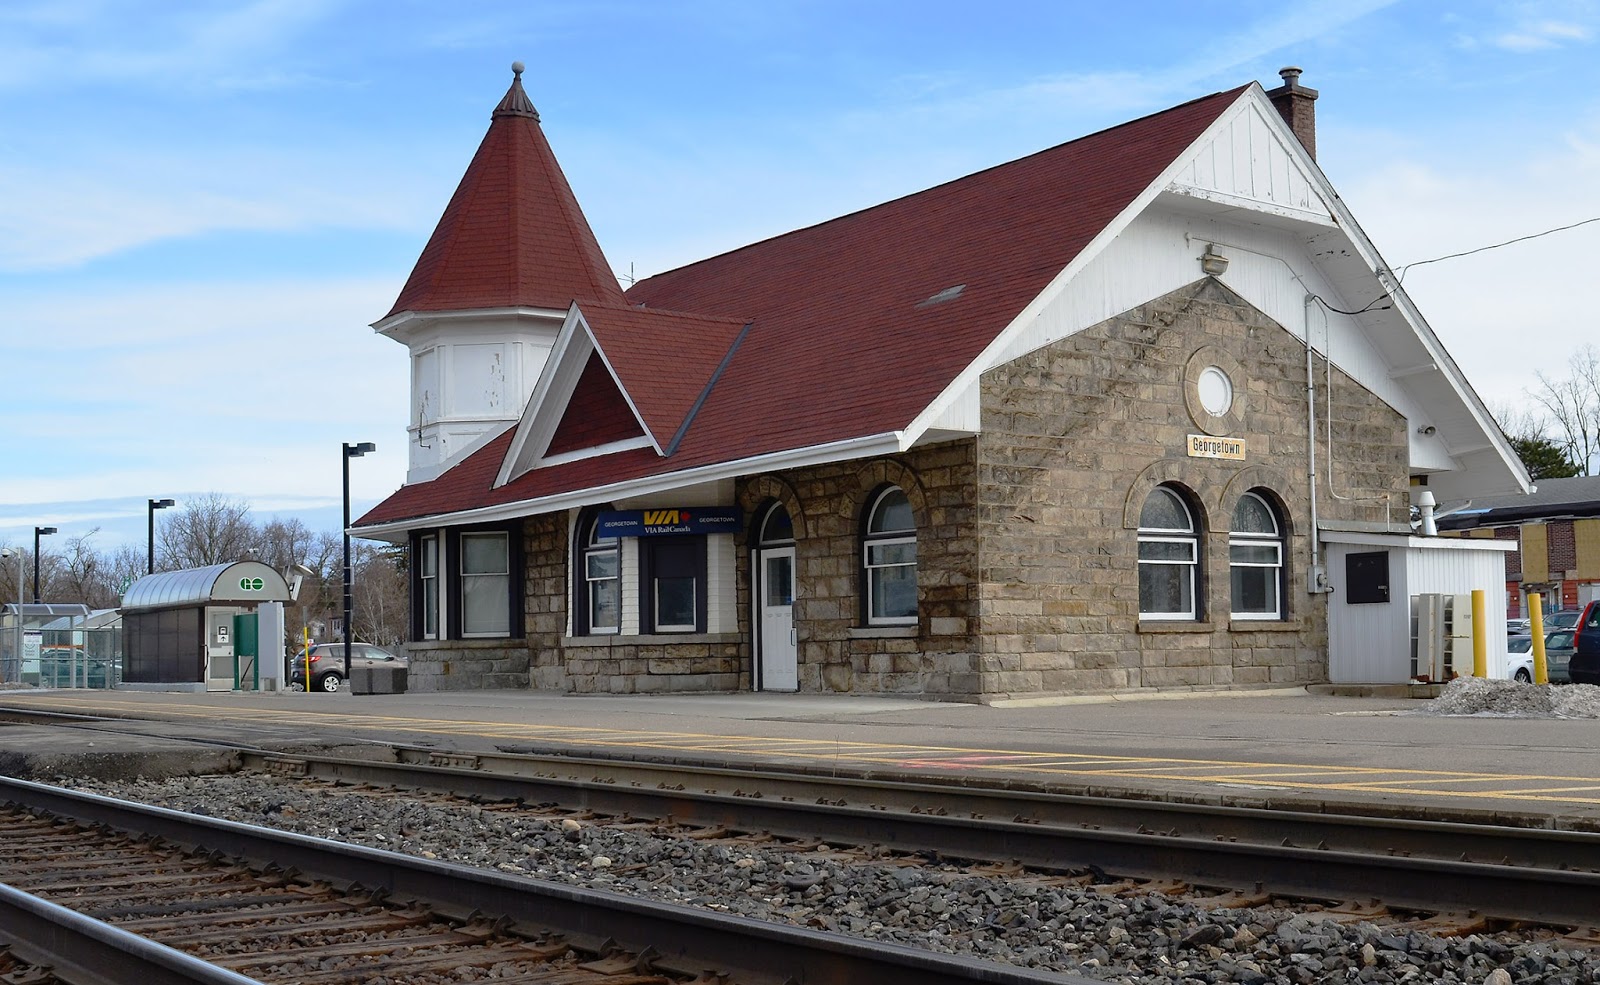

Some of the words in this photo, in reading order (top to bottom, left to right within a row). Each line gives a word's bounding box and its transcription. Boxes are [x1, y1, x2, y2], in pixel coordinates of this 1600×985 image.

[1193, 437, 1240, 454] Georgetown
[643, 510, 679, 525] VIA
[604, 520, 639, 528] GEORGETOWN
[644, 526, 657, 534] VIA
